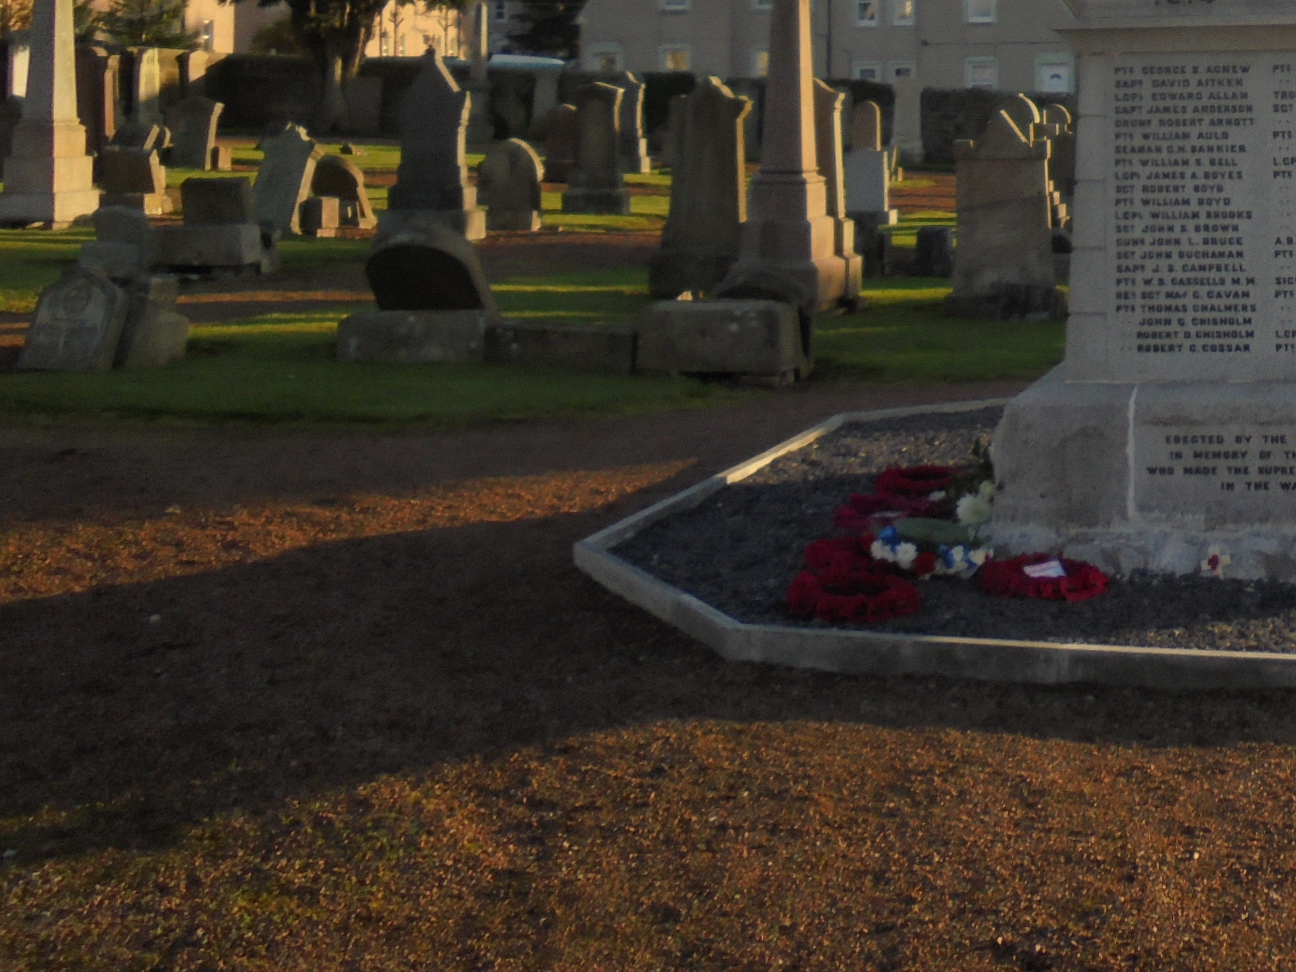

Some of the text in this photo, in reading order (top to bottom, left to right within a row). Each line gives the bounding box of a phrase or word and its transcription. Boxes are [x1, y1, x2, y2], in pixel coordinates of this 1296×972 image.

[1141, 65, 1187, 75] GEORGE
[1205, 65, 1250, 74] AGNEW
[1151, 79, 1190, 88] DAVID
[1196, 78, 1243, 88] AITKEN
[1151, 92, 1203, 101] EDWARD
[1146, 105, 1187, 114] JAMES
[1192, 104, 1253, 114] ANDERSON
[1158, 118, 1204, 127] ROBERT
[1142, 131, 1191, 141] WILLIAM
[1114, 145, 1163, 154] SEAMAN
[1190, 144, 1246, 153] BANKIER
[1139, 158, 1189, 167] WILLIAM
[1209, 157, 1238, 166] BELL
[1146, 171, 1186, 180] JAMES
[1203, 171, 1243, 180] BOYES
[1142, 184, 1186, 193] ROBERT
[1193, 184, 1224, 193] BOYD
[1141, 198, 1191, 207] WILLIAM
[1197, 197, 1231, 206] BOYD
[1150, 210, 1253, 220] WILLIAM BROOKS
[1141, 224, 1175, 233] JOHN
[1194, 224, 1239, 232] BROWN
[1149, 237, 1181, 246] JOHN
[1202, 237, 1244, 246] BRUCE
[1139, 251, 1172, 259] JOHN
[1178, 250, 1244, 259] BUCHANAN
[1182, 264, 1246, 272] CAMPBELL
[1171, 277, 1226, 286] CASSELLS
[1206, 290, 1250, 299] CAVAN
[1140, 304, 1188, 313] THOMAS
[1192, 304, 1257, 313] CHALMERS
[1139, 317, 1252, 326] JOHN CHISHOLM
[1136, 330, 1255, 339] ROBERT CHISHOLM
[1137, 344, 1250, 353] ROBERT COSSAR
[1165, 435, 1224, 444] ERECTED
[1235, 435, 1252, 444] BY
[1261, 435, 1288, 444] THE
[1169, 450, 1183, 460] IN
[1193, 450, 1248, 460] MEMORY
[1259, 450, 1272, 460] OF
[1146, 466, 1175, 476] WHO
[1183, 466, 1218, 476] MADE
[1226, 466, 1250, 475] THE
[1221, 481, 1235, 491] IN
[1244, 481, 1270, 491] THE
